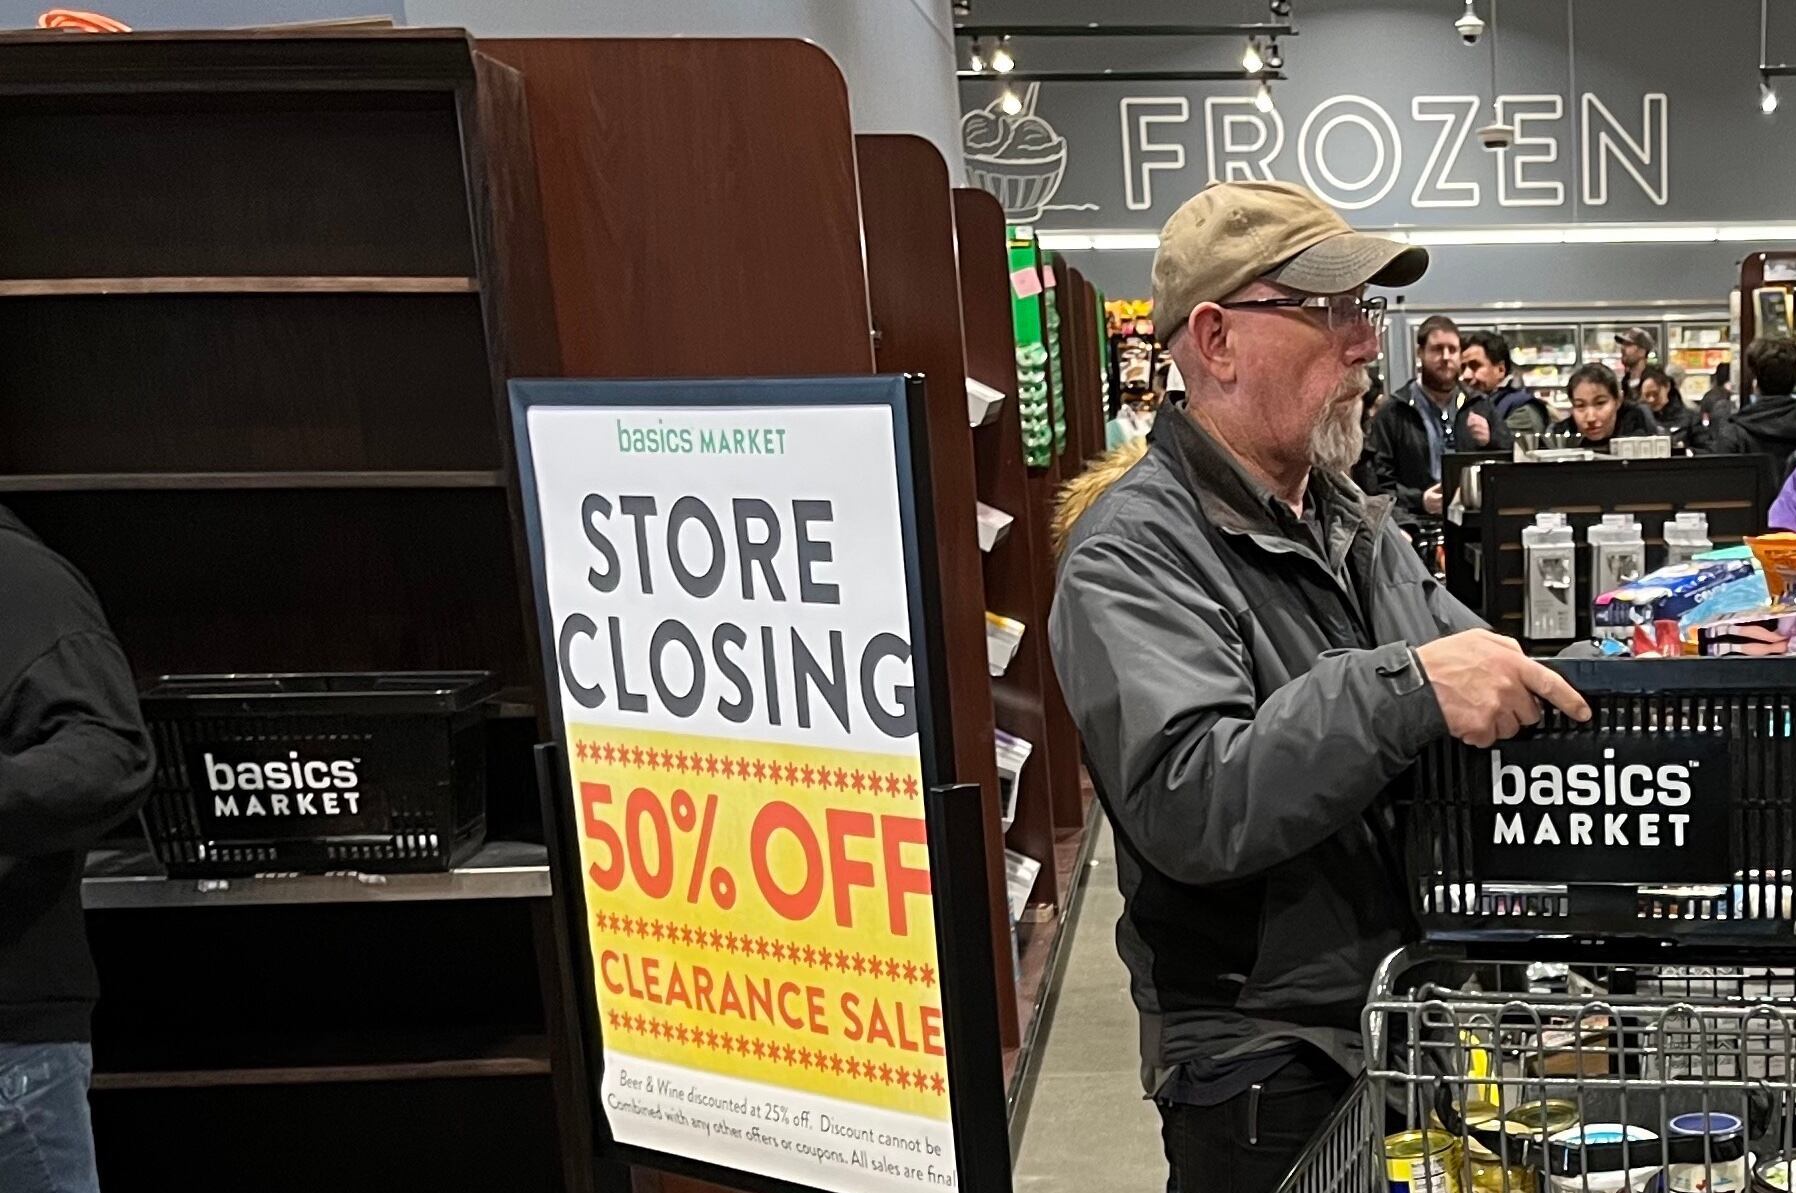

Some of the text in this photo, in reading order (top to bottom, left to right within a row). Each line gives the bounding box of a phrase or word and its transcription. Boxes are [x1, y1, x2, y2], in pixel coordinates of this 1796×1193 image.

[1120, 92, 1667, 211] FROZEN
[617, 419, 786, 455] basics MARKET
[581, 493, 840, 604] STORE
[558, 612, 919, 738] CLOSING
[204, 751, 358, 791] basics
[214, 792, 360, 817] MARKET
[1491, 748, 1692, 806] basics
[579, 781, 933, 937] 50% OFF
[1493, 812, 1690, 847] MARKET
[600, 949, 946, 1057] CLEARANCE SALE
[607, 1093, 956, 1187] Combined with any other offers or coupons. All sales are final
[619, 1069, 643, 1090] Beer
[645, 1075, 654, 1093] &
[657, 1077, 685, 1101] Wine
[687, 1085, 748, 1115] discounted
[750, 1103, 761, 1118] at
[764, 1102, 790, 1126] 25%
[820, 1114, 874, 1143] Discount
[878, 1132, 921, 1153] cannot
[925, 1136, 942, 1157] be
